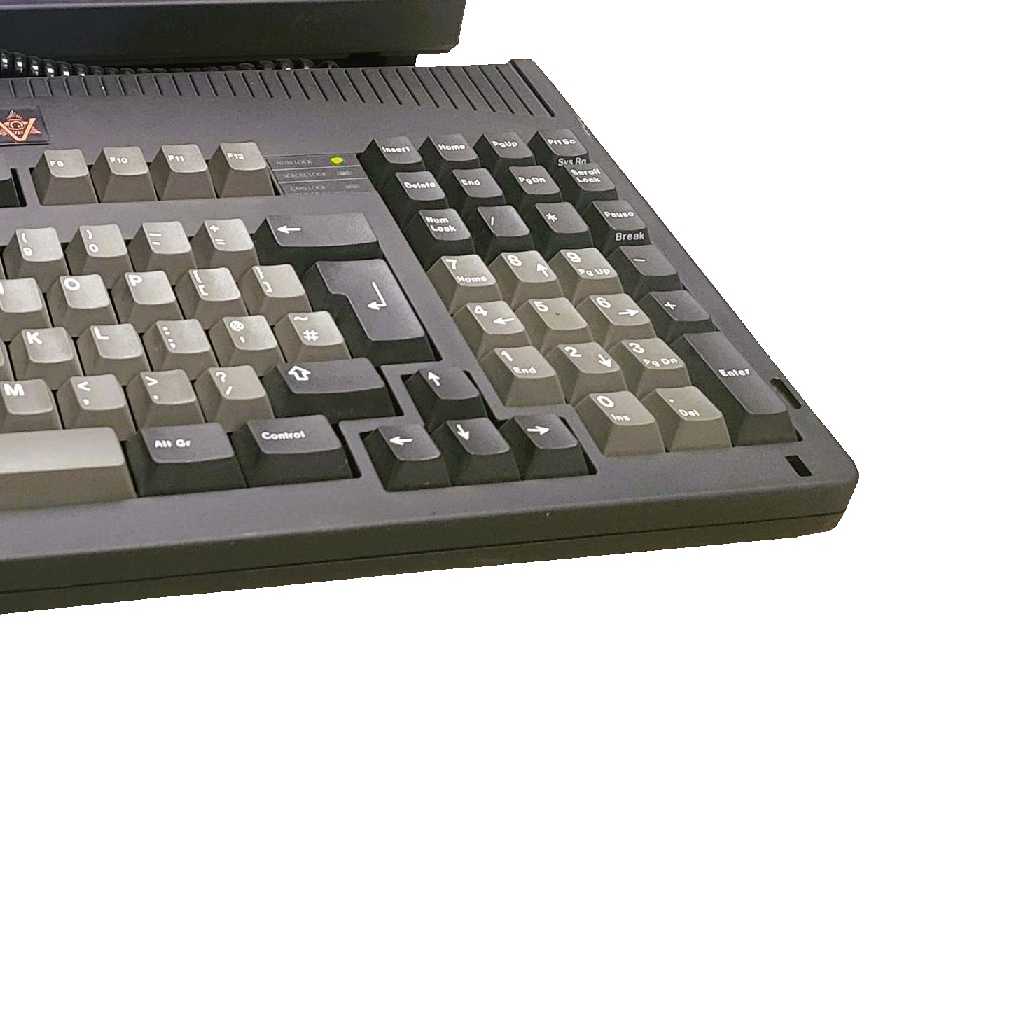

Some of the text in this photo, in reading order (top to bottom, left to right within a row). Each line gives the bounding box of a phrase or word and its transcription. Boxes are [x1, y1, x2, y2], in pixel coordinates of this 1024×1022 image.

[382, 145, 410, 153] Insert
[438, 143, 466, 151] Home
[492, 140, 518, 148] PgUp
[570, 168, 602, 176] Scroll
[404, 180, 436, 189] Delete
[430, 224, 456, 233] Lock
[616, 232, 644, 242] Break
[508, 255, 522, 266] 8
[566, 252, 582, 263] 9
[446, 258, 458, 270] 7
[64, 277, 80, 291] O
[128, 274, 143, 286] P
[457, 276, 488, 284] Home
[534, 301, 548, 312] 5
[596, 296, 612, 308] 6
[474, 306, 488, 316] 4
[229, 320, 246, 332] @
[94, 327, 110, 340] L
[302, 330, 320, 342] #
[26, 332, 43, 346] K
[564, 346, 582, 358] 2
[629, 342, 645, 354] 3
[500, 350, 513, 362] 1
[662, 357, 678, 365] Dn
[513, 366, 536, 374] End
[718, 368, 750, 378] Enter
[2, 382, 25, 396] M
[678, 408, 700, 417] Del
[610, 414, 631, 422] Ins
[262, 430, 306, 440] Control
[154, 438, 191, 448] Alt Gr
